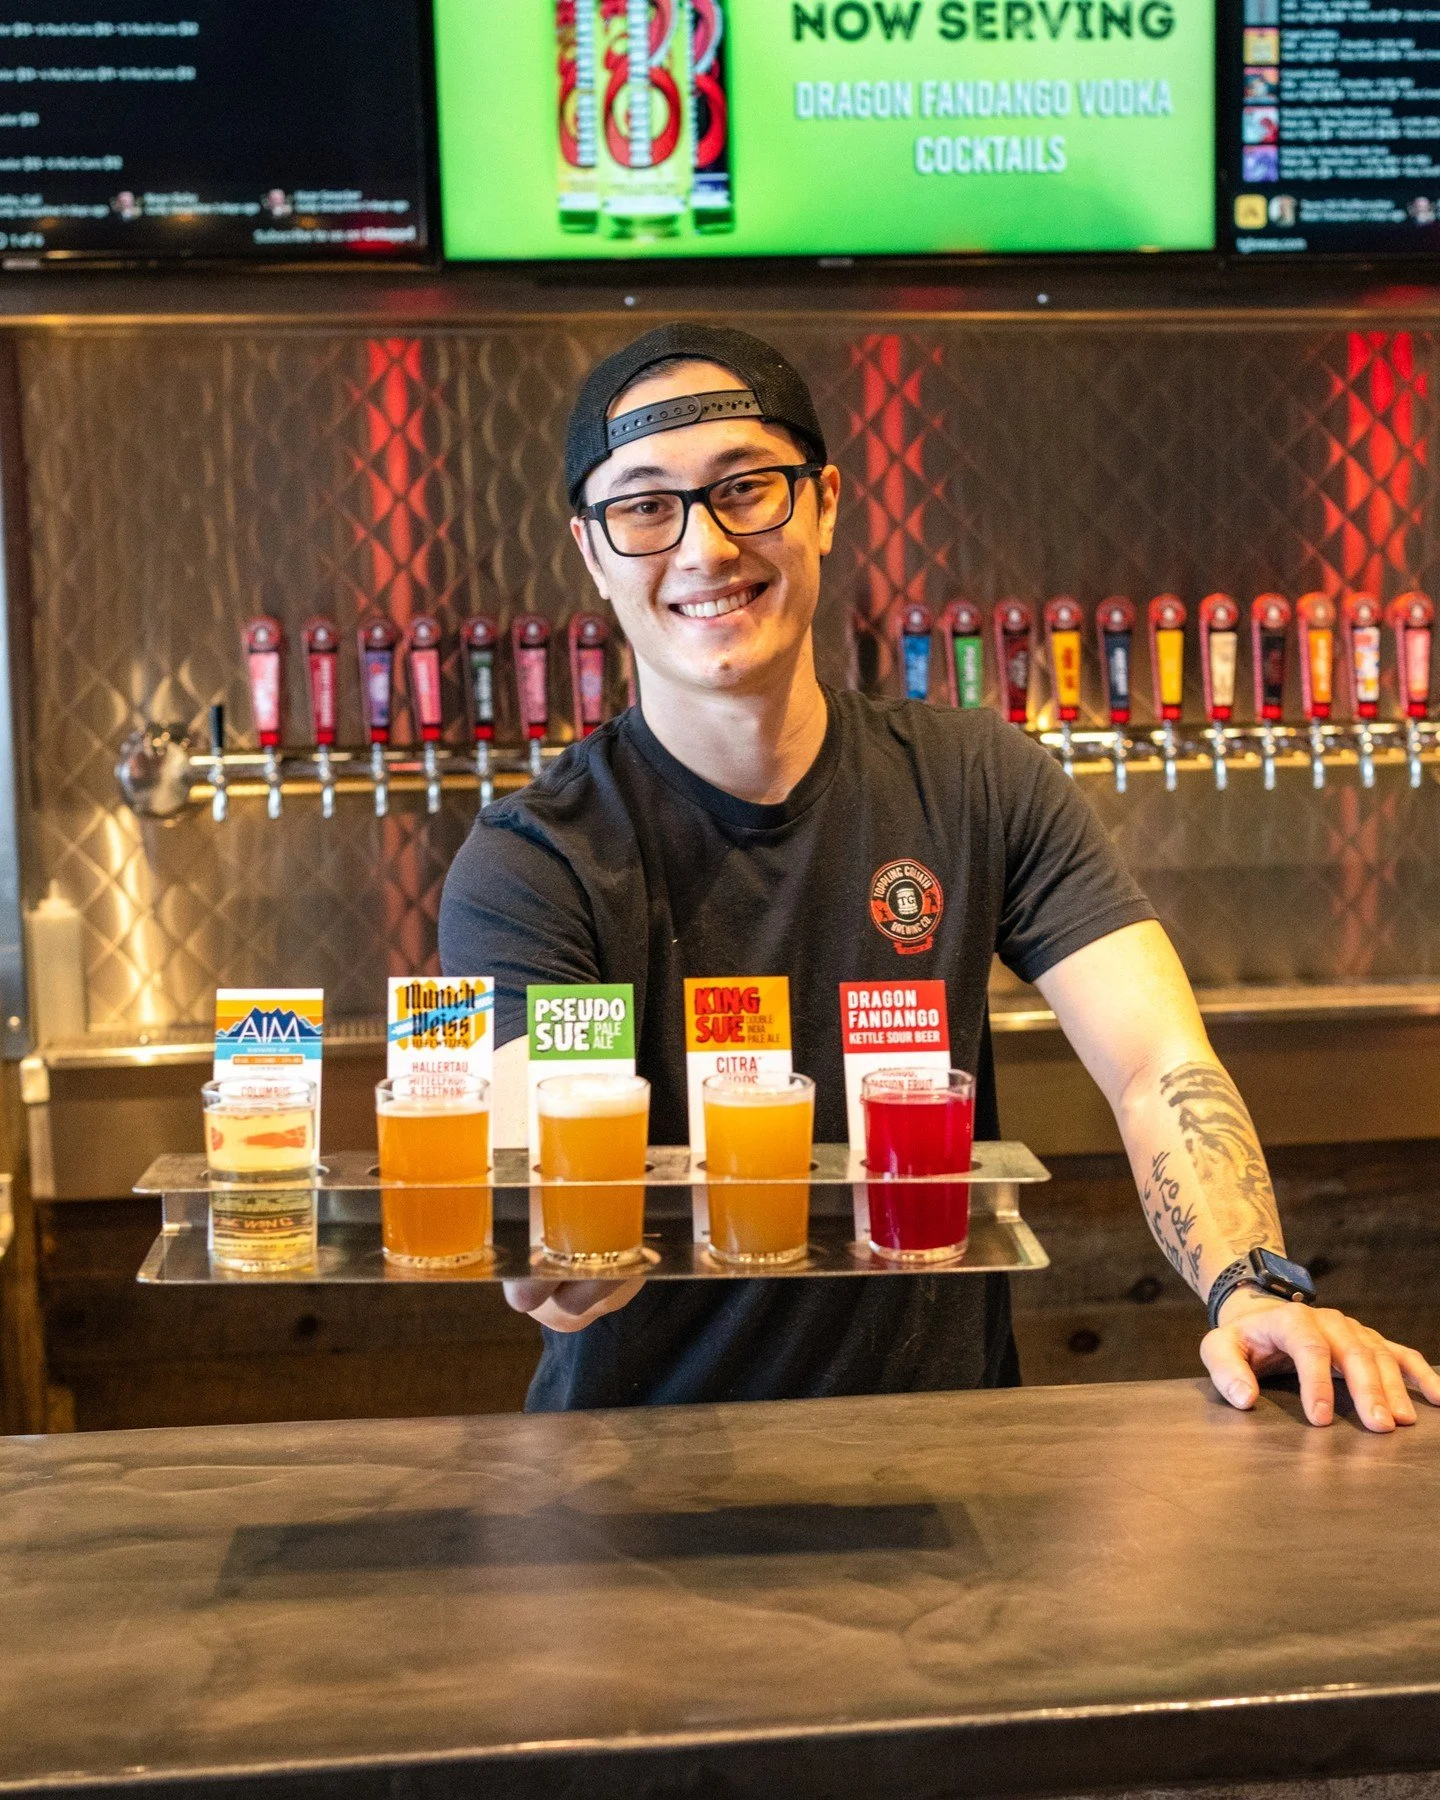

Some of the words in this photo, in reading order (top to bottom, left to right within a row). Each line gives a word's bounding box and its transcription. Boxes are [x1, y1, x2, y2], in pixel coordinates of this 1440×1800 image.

[793, 0, 921, 41] NOW
[938, 0, 1176, 40] SERVING
[794, 81, 912, 119] DRAGON
[920, 79, 1071, 118] FANDANGO
[1079, 78, 1173, 117] VODKA
[915, 135, 1067, 174] COCKTAILS
[900, 894, 916, 907] TG
[406, 983, 475, 1009] Munich
[694, 987, 760, 1015] KING
[847, 989, 917, 1009] DRAGON
[534, 997, 626, 1022] PSEUDO
[848, 1008, 940, 1028] FANDANGO
[237, 1016, 302, 1044] AIM
[412, 1011, 470, 1038] Weiss
[535, 1021, 591, 1051] SUE
[594, 1022, 622, 1037] PALE
[695, 1016, 746, 1043] SUE
[849, 1031, 885, 1044] KETTLE
[887, 1031, 913, 1044] SOUR
[915, 1030, 940, 1043] BEER
[593, 1036, 614, 1049] ALE
[412, 1061, 469, 1073] HALLERTAU
